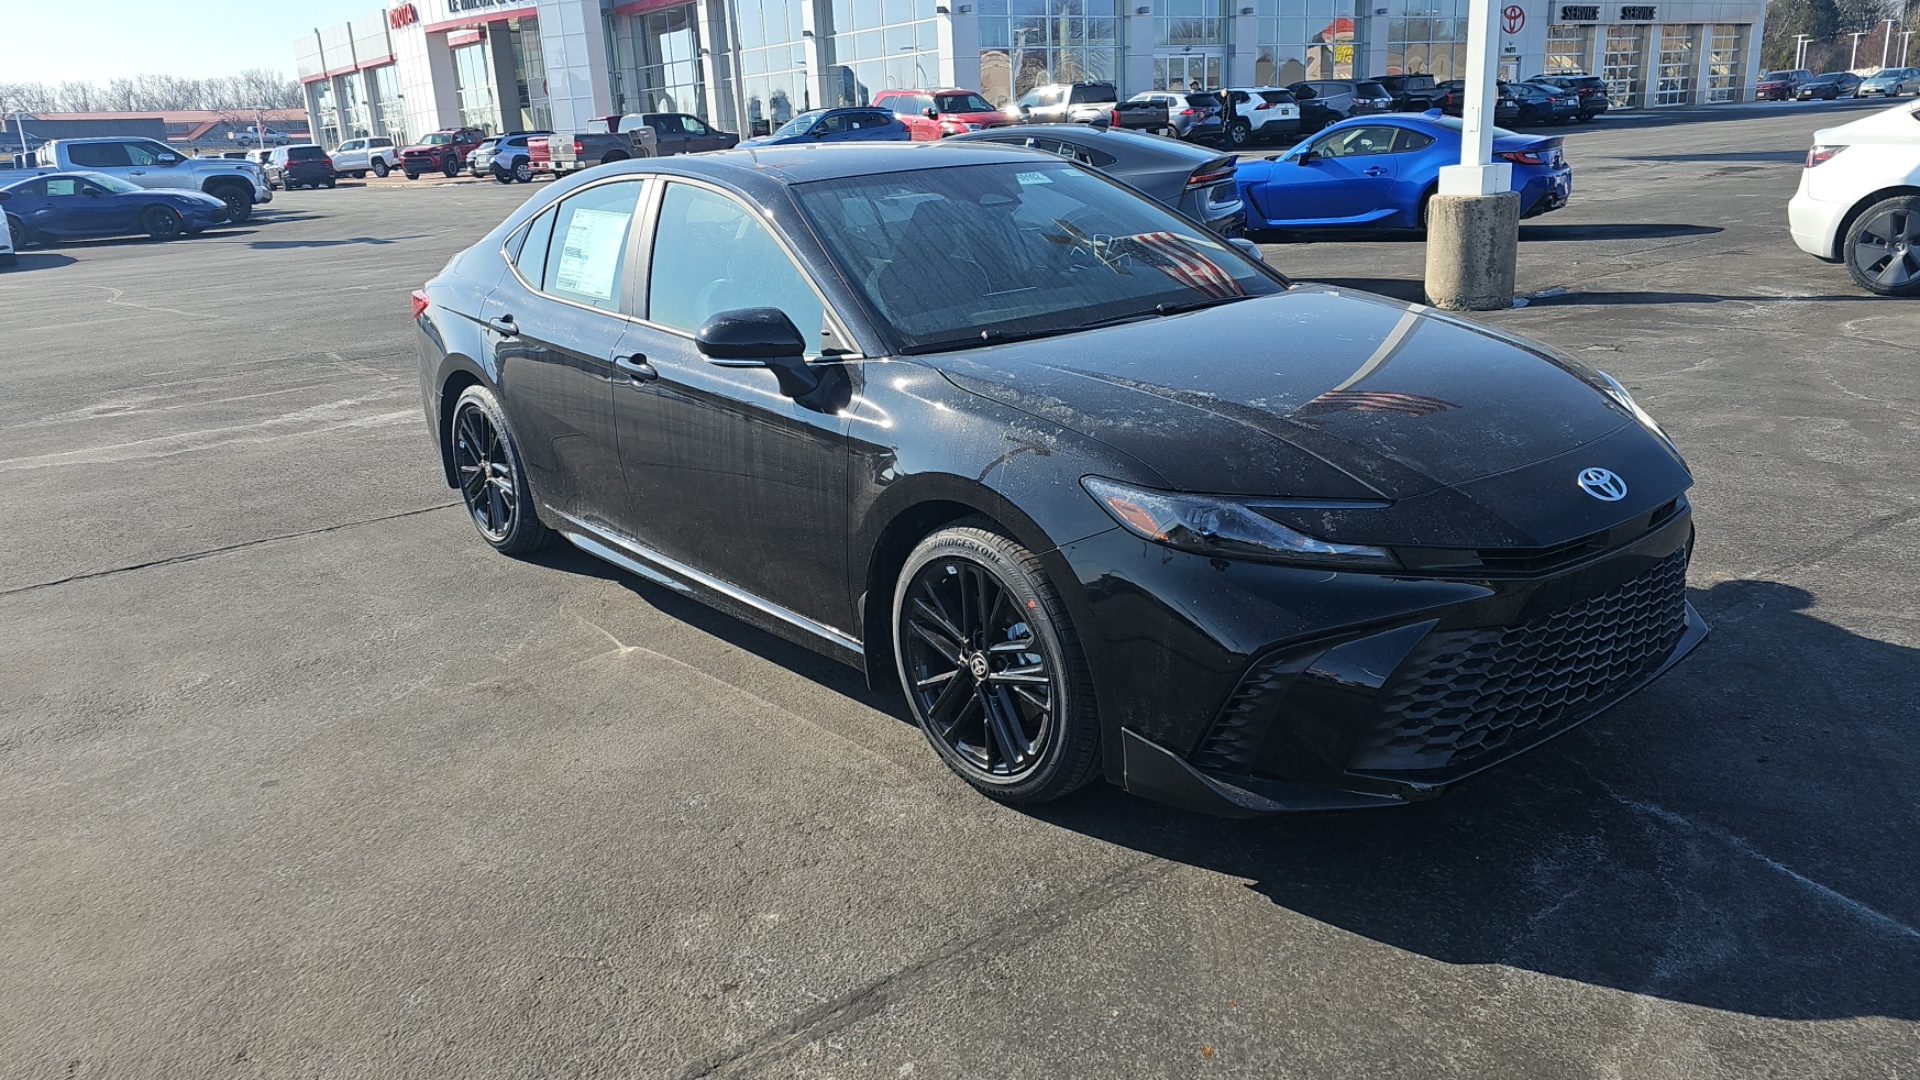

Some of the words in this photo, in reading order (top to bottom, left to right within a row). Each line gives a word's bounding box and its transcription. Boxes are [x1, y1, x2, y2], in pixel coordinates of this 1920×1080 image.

[388, 3, 415, 30] TOYOTA
[1561, 6, 1599, 20] SERVICE
[1620, 6, 1656, 20] SERVICE
[934, 538, 1006, 565] BRIDGESTONE
